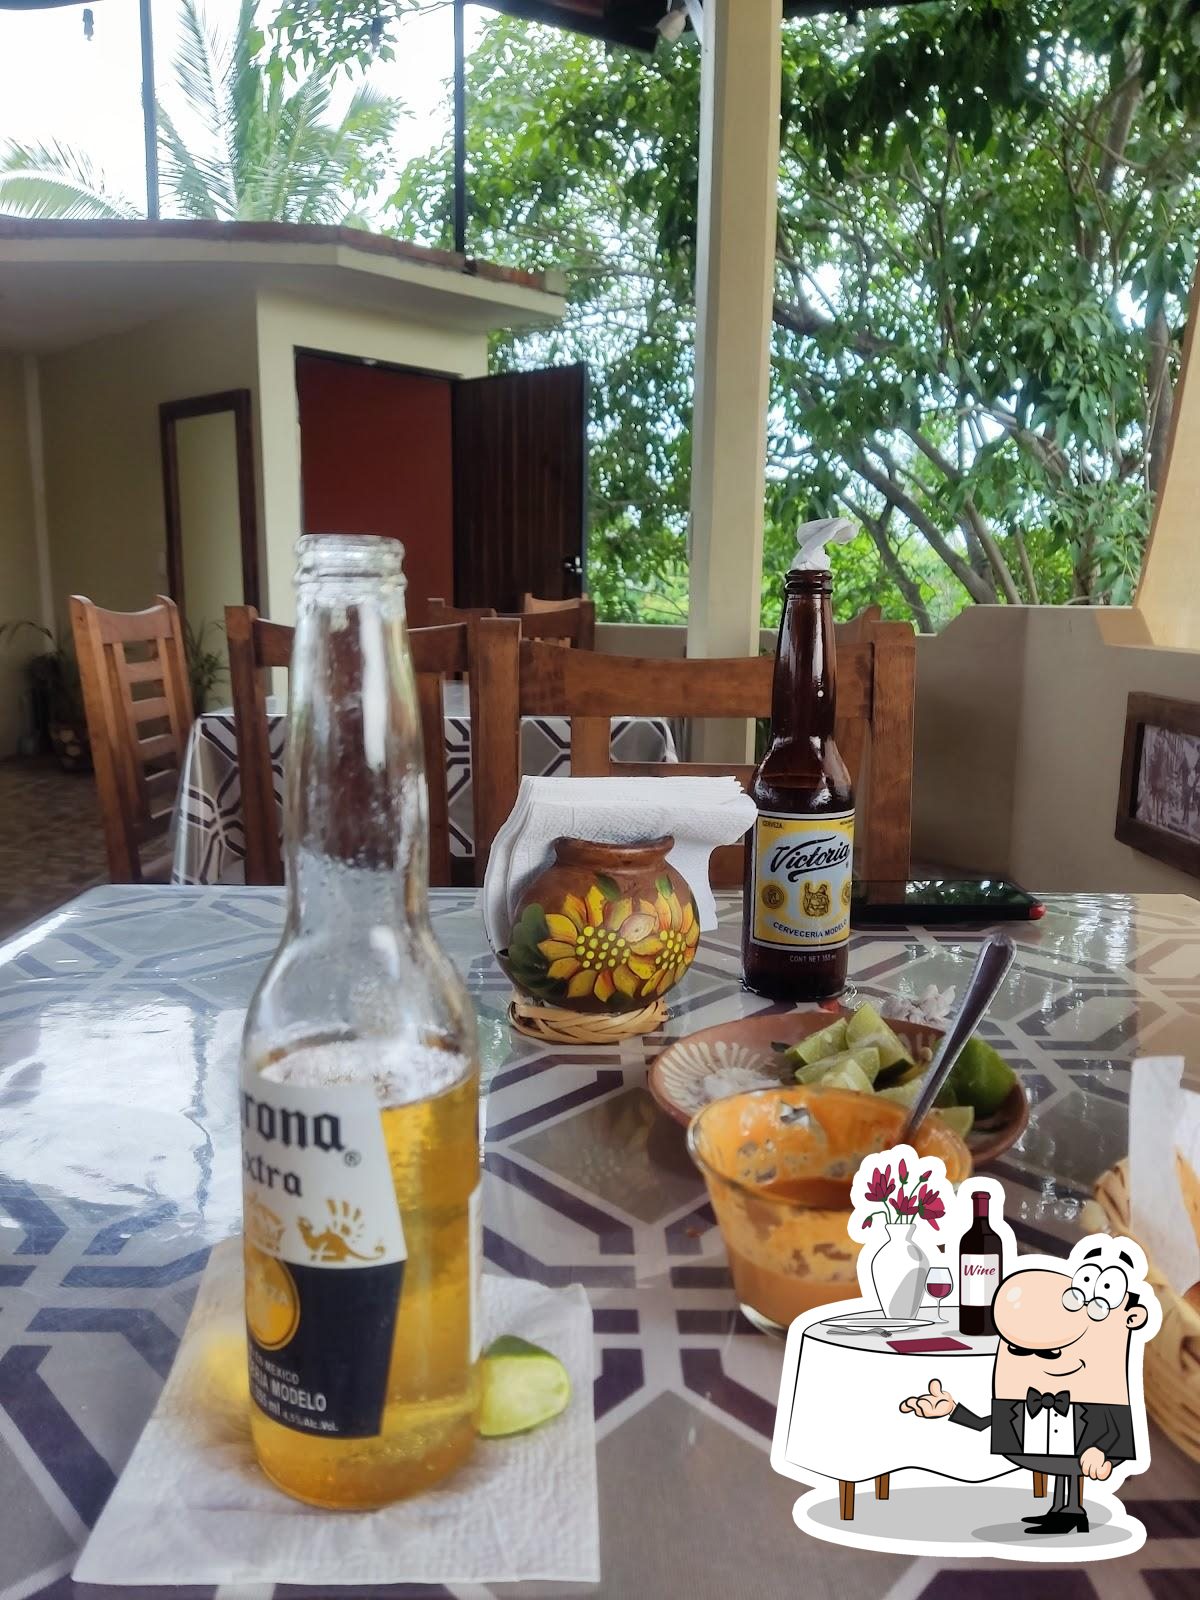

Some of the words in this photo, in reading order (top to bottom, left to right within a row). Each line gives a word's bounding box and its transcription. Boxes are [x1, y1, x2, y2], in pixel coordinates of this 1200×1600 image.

[770, 835, 850, 882] Victoria
[773, 921, 823, 938] CERVECERIA
[270, 1378, 327, 1413] MODELO
